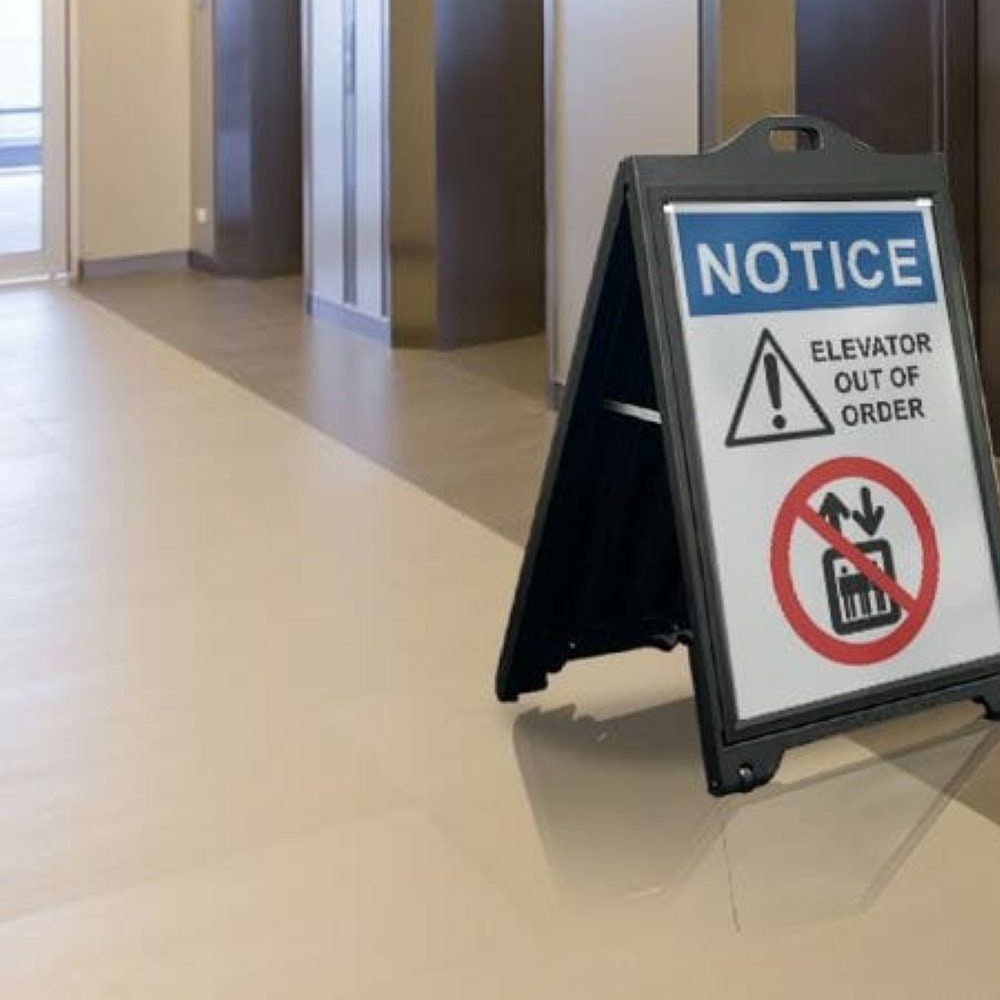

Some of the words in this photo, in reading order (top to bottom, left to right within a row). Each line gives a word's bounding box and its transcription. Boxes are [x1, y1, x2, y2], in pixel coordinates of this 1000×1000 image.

[696, 238, 923, 296] NOTICE
[810, 332, 933, 362] ELEVATOR
[834, 368, 883, 393] OUT
[890, 366, 920, 388] OF
[841, 398, 925, 426] ORDER
